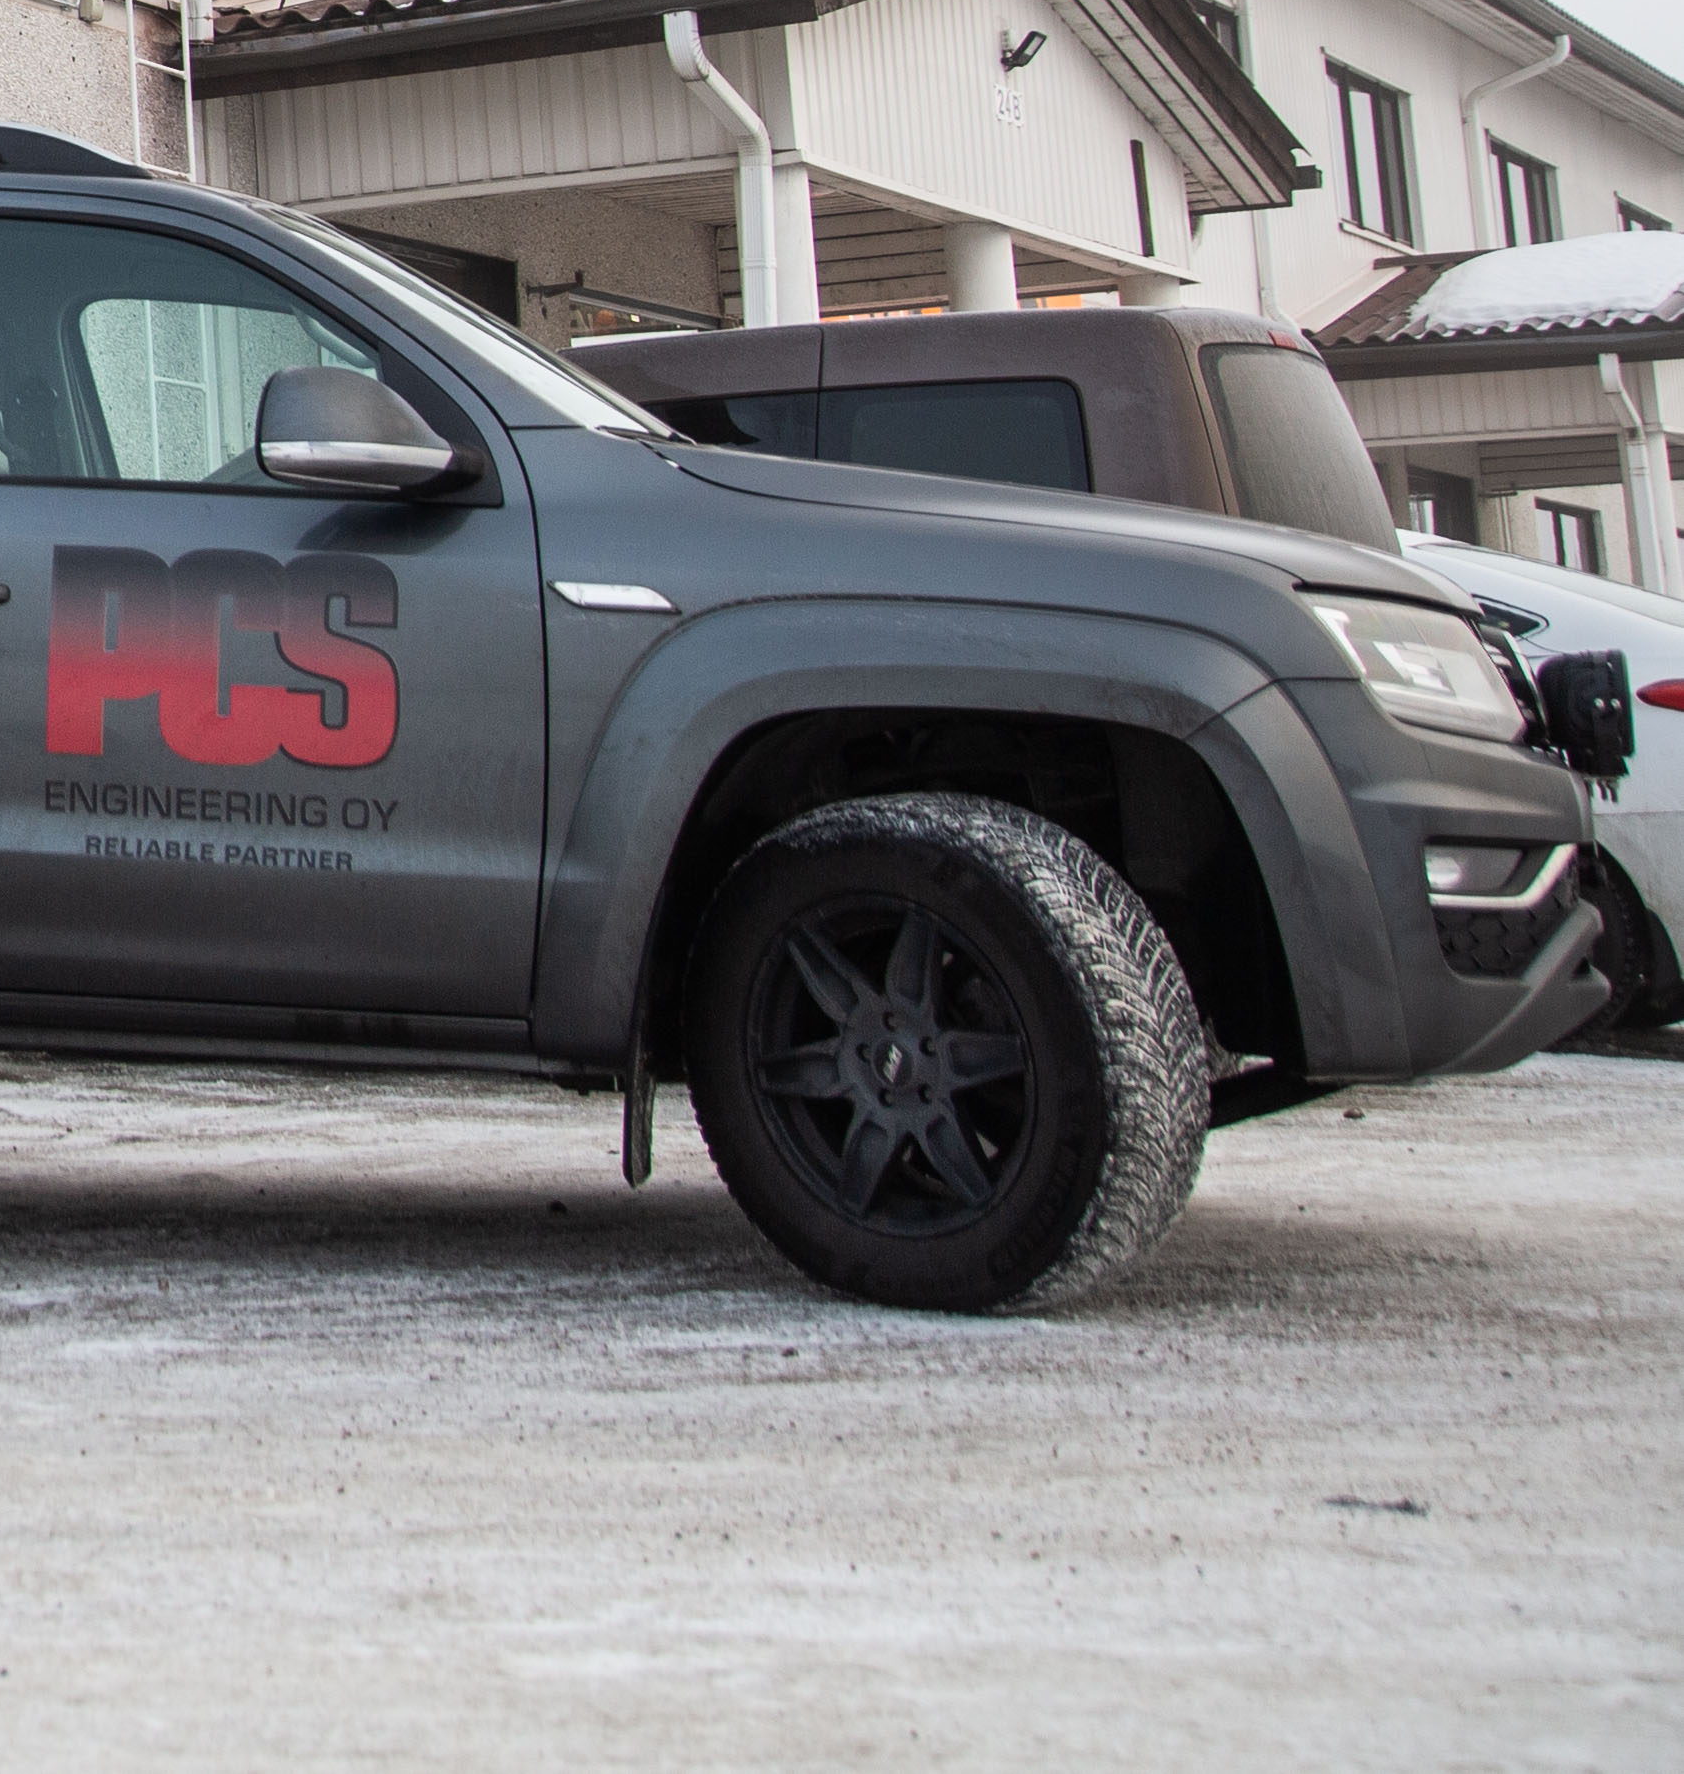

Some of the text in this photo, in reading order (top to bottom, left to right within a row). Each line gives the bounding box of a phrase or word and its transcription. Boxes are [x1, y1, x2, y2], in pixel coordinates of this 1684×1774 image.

[45, 544, 399, 770] PCS
[44, 779, 398, 832] ENGINEERING OY
[85, 834, 353, 872] RELIABLE PARTNER
